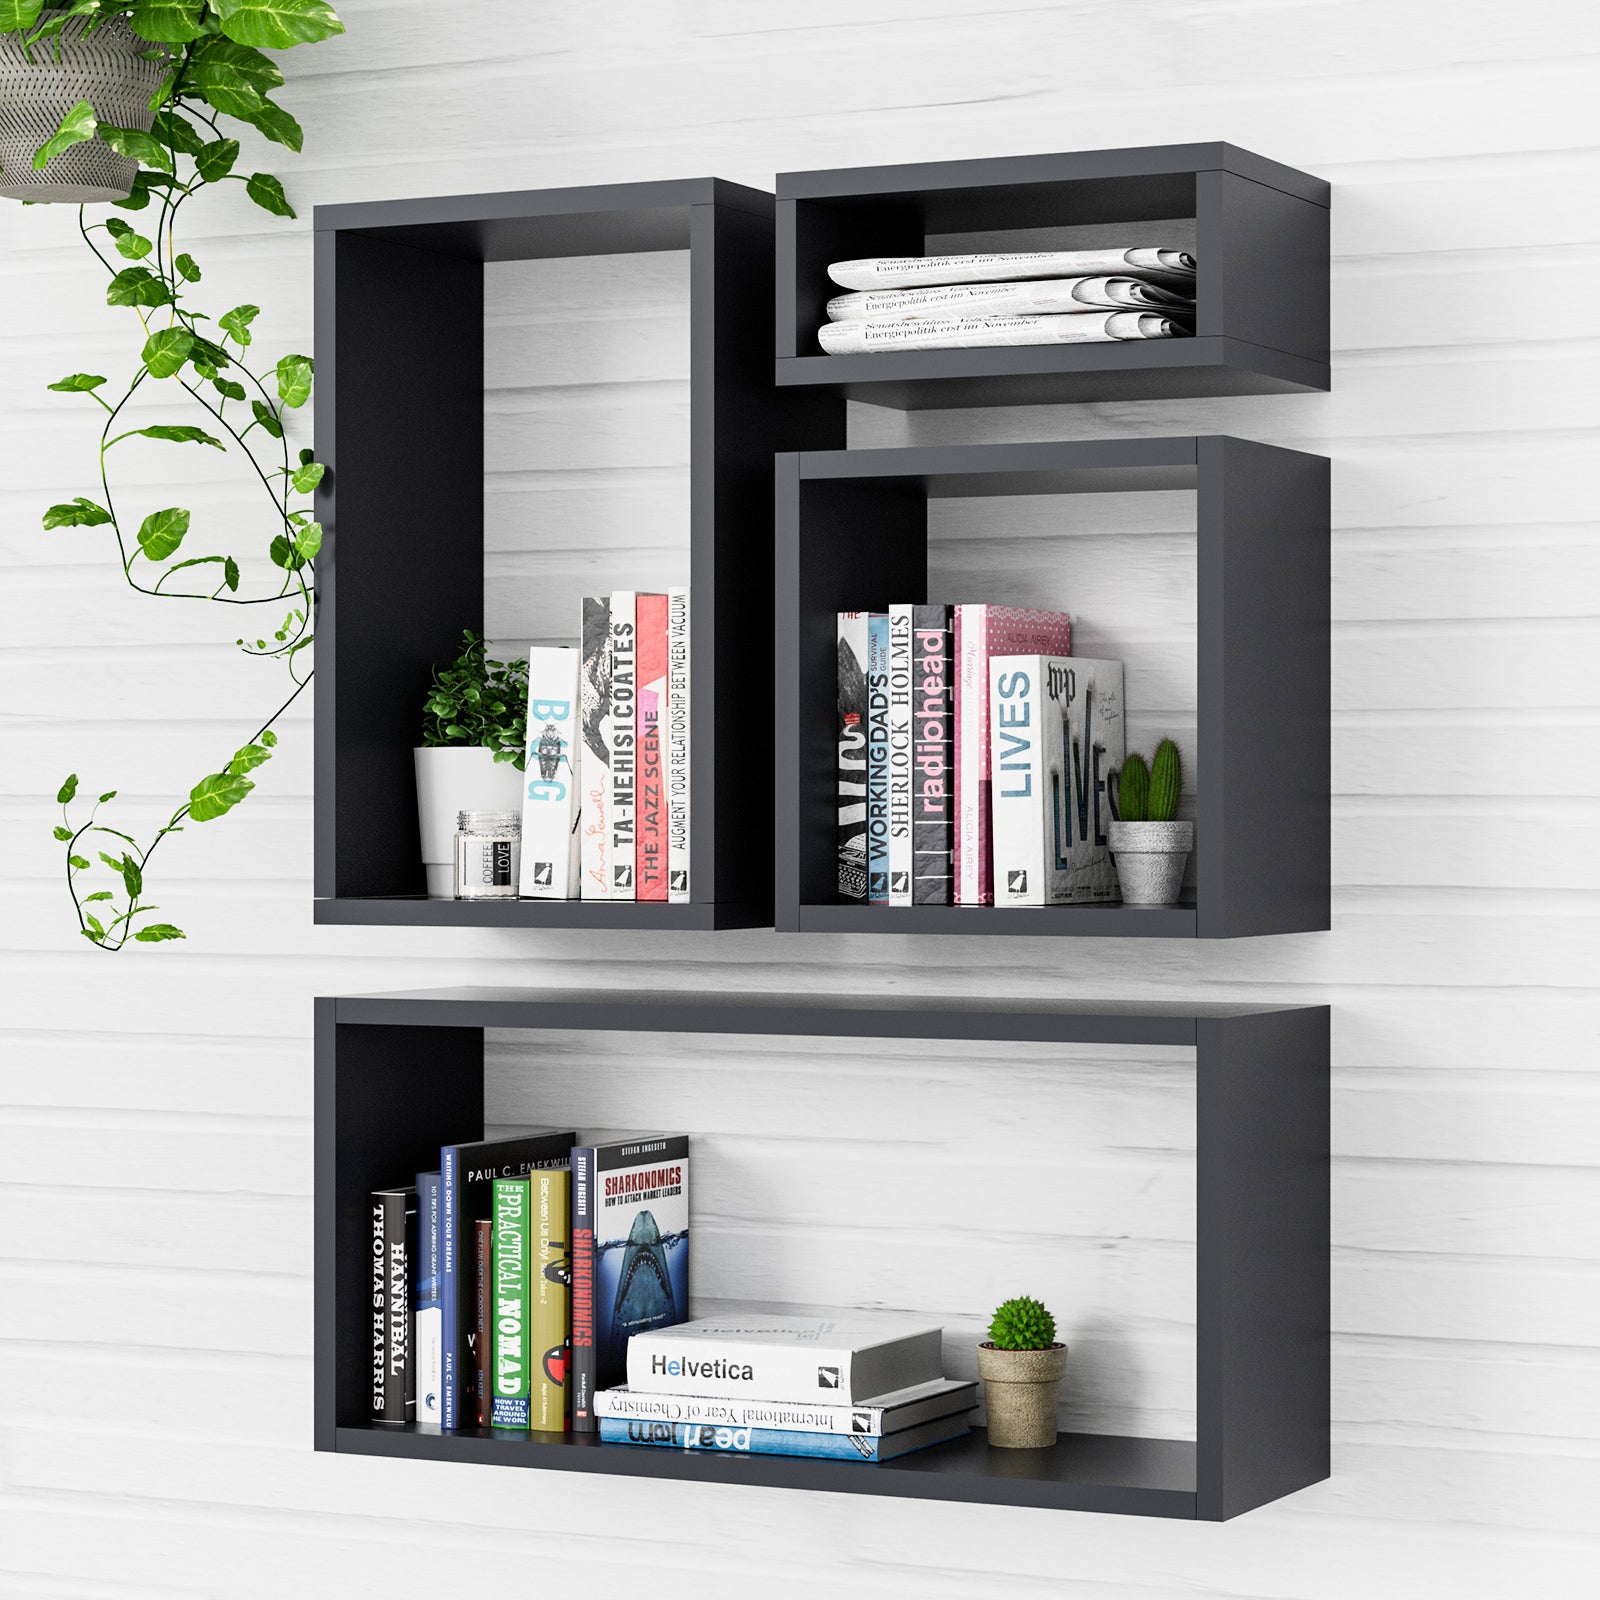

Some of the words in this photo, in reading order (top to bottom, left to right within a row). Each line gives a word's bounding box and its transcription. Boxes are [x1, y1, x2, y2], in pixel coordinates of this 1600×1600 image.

[865, 296, 928, 311] Energiepolitik
[930, 293, 948, 301] erst
[968, 286, 1017, 297] November
[865, 324, 937, 339] Energiepolitik
[940, 324, 961, 332] erst
[983, 319, 1038, 329] November
[671, 594, 687, 637] VACUUM
[613, 622, 634, 719] COATES
[671, 639, 687, 690] BETWEEN
[870, 633, 878, 672] SURVIVAL
[879, 647, 887, 672] GUIDE
[890, 613, 910, 706] HOLMES
[671, 692, 687, 768] RELATIONSHIP
[915, 629, 944, 812] radiohead
[997, 670, 1032, 798] LIVES
[528, 699, 570, 802] BUG
[644, 710, 659, 780] SCENE
[613, 725, 634, 847] TA-NEHISI
[671, 770, 687, 798] YOUR
[890, 719, 910, 838] SHERLOCK
[644, 784, 659, 837] JAZZ
[869, 747, 888, 861] WORKING
[671, 799, 687, 850] AUGMENT
[966, 805, 974, 842] ALICIA
[482, 844, 493, 884] COFFEE
[498, 843, 509, 873] LOVE
[588, 844, 608, 894] Anna
[644, 843, 659, 884] THE
[966, 845, 974, 880] AIREY
[621, 1146, 640, 1156] STEFAN
[641, 1142, 666, 1153] ENGESETH
[468, 1168, 498, 1182] PAUL
[502, 1165, 515, 1177] C.
[577, 1156, 586, 1181] STEFAN
[605, 1166, 682, 1196] SHARKONOMICS
[496, 1184, 524, 1193] THE
[539, 1178, 549, 1222] Between
[577, 1183, 586, 1216] ENGESETH
[605, 1197, 616, 1207] HOW
[617, 1195, 624, 1205] TO
[624, 1193, 642, 1204] ATTACK
[643, 1189, 661, 1201] MARKET
[662, 1186, 682, 1198] LEADERS
[497, 1193, 522, 1294] PRACTICAL
[539, 1222, 549, 1237] Us
[372, 1204, 385, 1310] THOMAS
[538, 1237, 549, 1260] Only!
[539, 1279, 548, 1297] Takes
[573, 1228, 592, 1347] SHARKONOMICS
[390, 1242, 406, 1376] HANNIBAL
[372, 1312, 385, 1411] HARRIS
[497, 1298, 522, 1395] NOMAD
[445, 1374, 452, 1384] C.
[652, 1354, 754, 1381] Helvetica
[493, 1410, 527, 1418] AROUND
[495, 1404, 525, 1412] TRAVEL
[608, 1396, 682, 1420] Chemistry
[685, 1404, 701, 1421] of
[706, 1406, 737, 1424] Year
[741, 1408, 834, 1431] International
[684, 1424, 752, 1452] pearl
